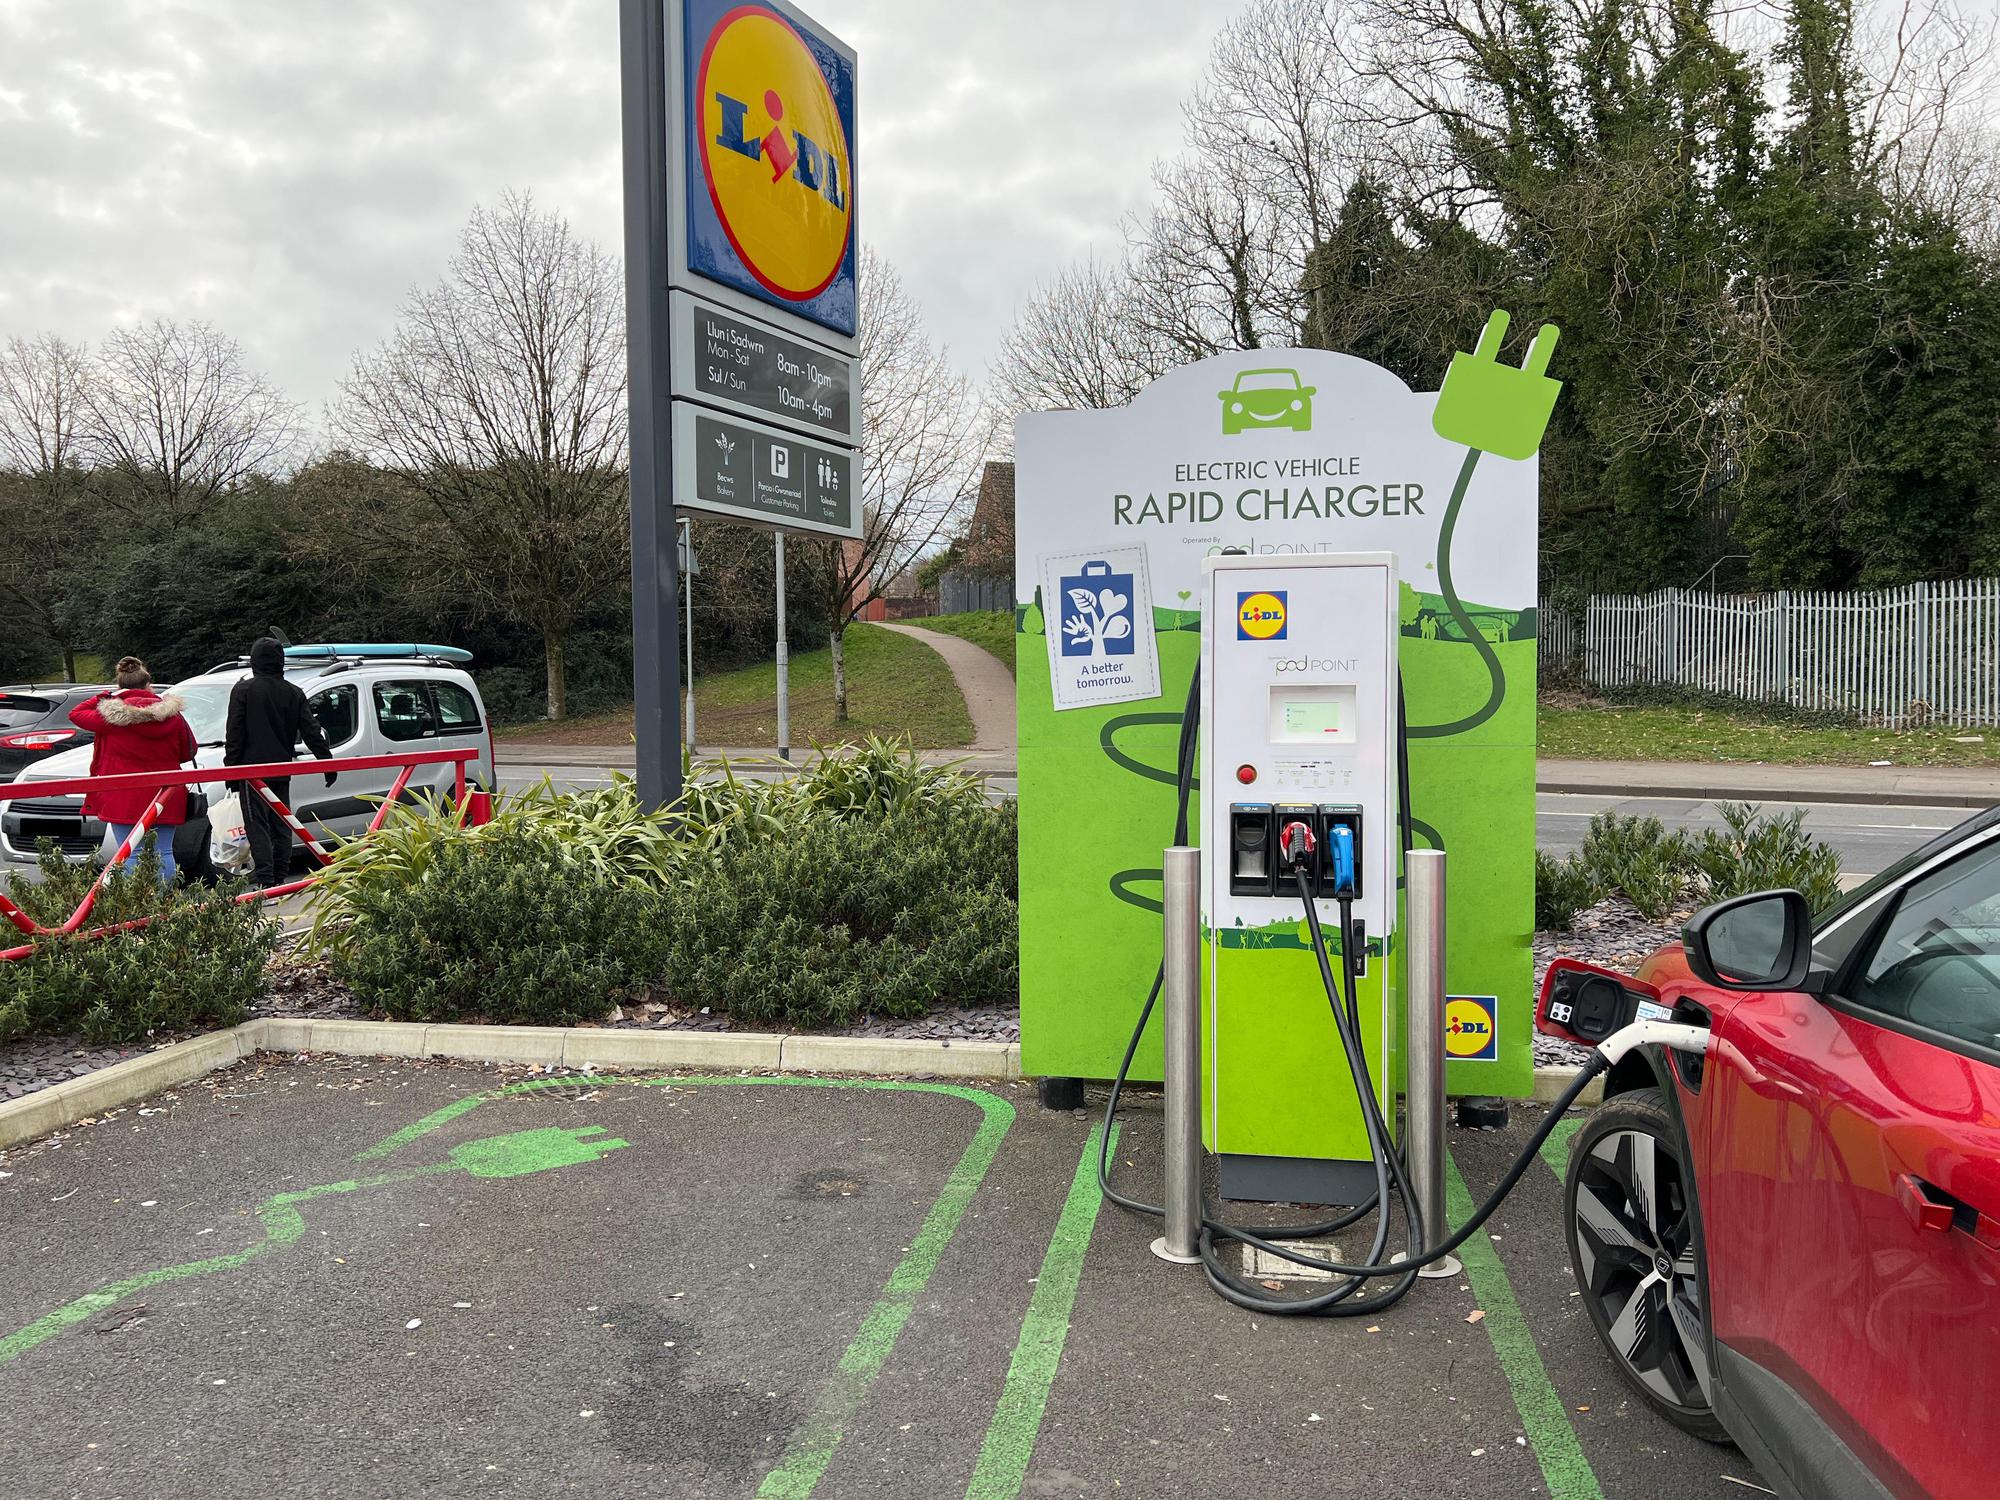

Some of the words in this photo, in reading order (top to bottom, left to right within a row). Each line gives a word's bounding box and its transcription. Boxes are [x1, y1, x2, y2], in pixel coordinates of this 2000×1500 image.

[707, 320, 726, 339] Llun
[730, 329, 765, 355] Sadwrn
[707, 340, 730, 360] Mon
[735, 350, 750, 367] Sat
[708, 365, 722, 385] Sul
[724, 370, 729, 385] /
[730, 372, 747, 391] Sun
[777, 353, 800, 378] 8am
[806, 363, 832, 389] 10pm
[777, 385, 805, 411] 10am
[811, 399, 833, 421] 4pm
[775, 449, 786, 474] P
[1175, 460, 1268, 483] ELECTRIC
[1274, 456, 1361, 479] VEHICLE
[716, 484, 735, 499] Bakery
[1114, 490, 1225, 526] RAPID
[1236, 482, 1426, 522] CHARGER
[1182, 536, 1212, 545] Operated
[1212, 536, 1222, 544] By
[1081, 665, 1090, 676] A
[1091, 661, 1125, 675] better
[1276, 655, 1307, 677] pod
[1310, 659, 1360, 672] POINT
[1076, 674, 1134, 689] tomorrow.
[1445, 1016, 1489, 1036] iDL
